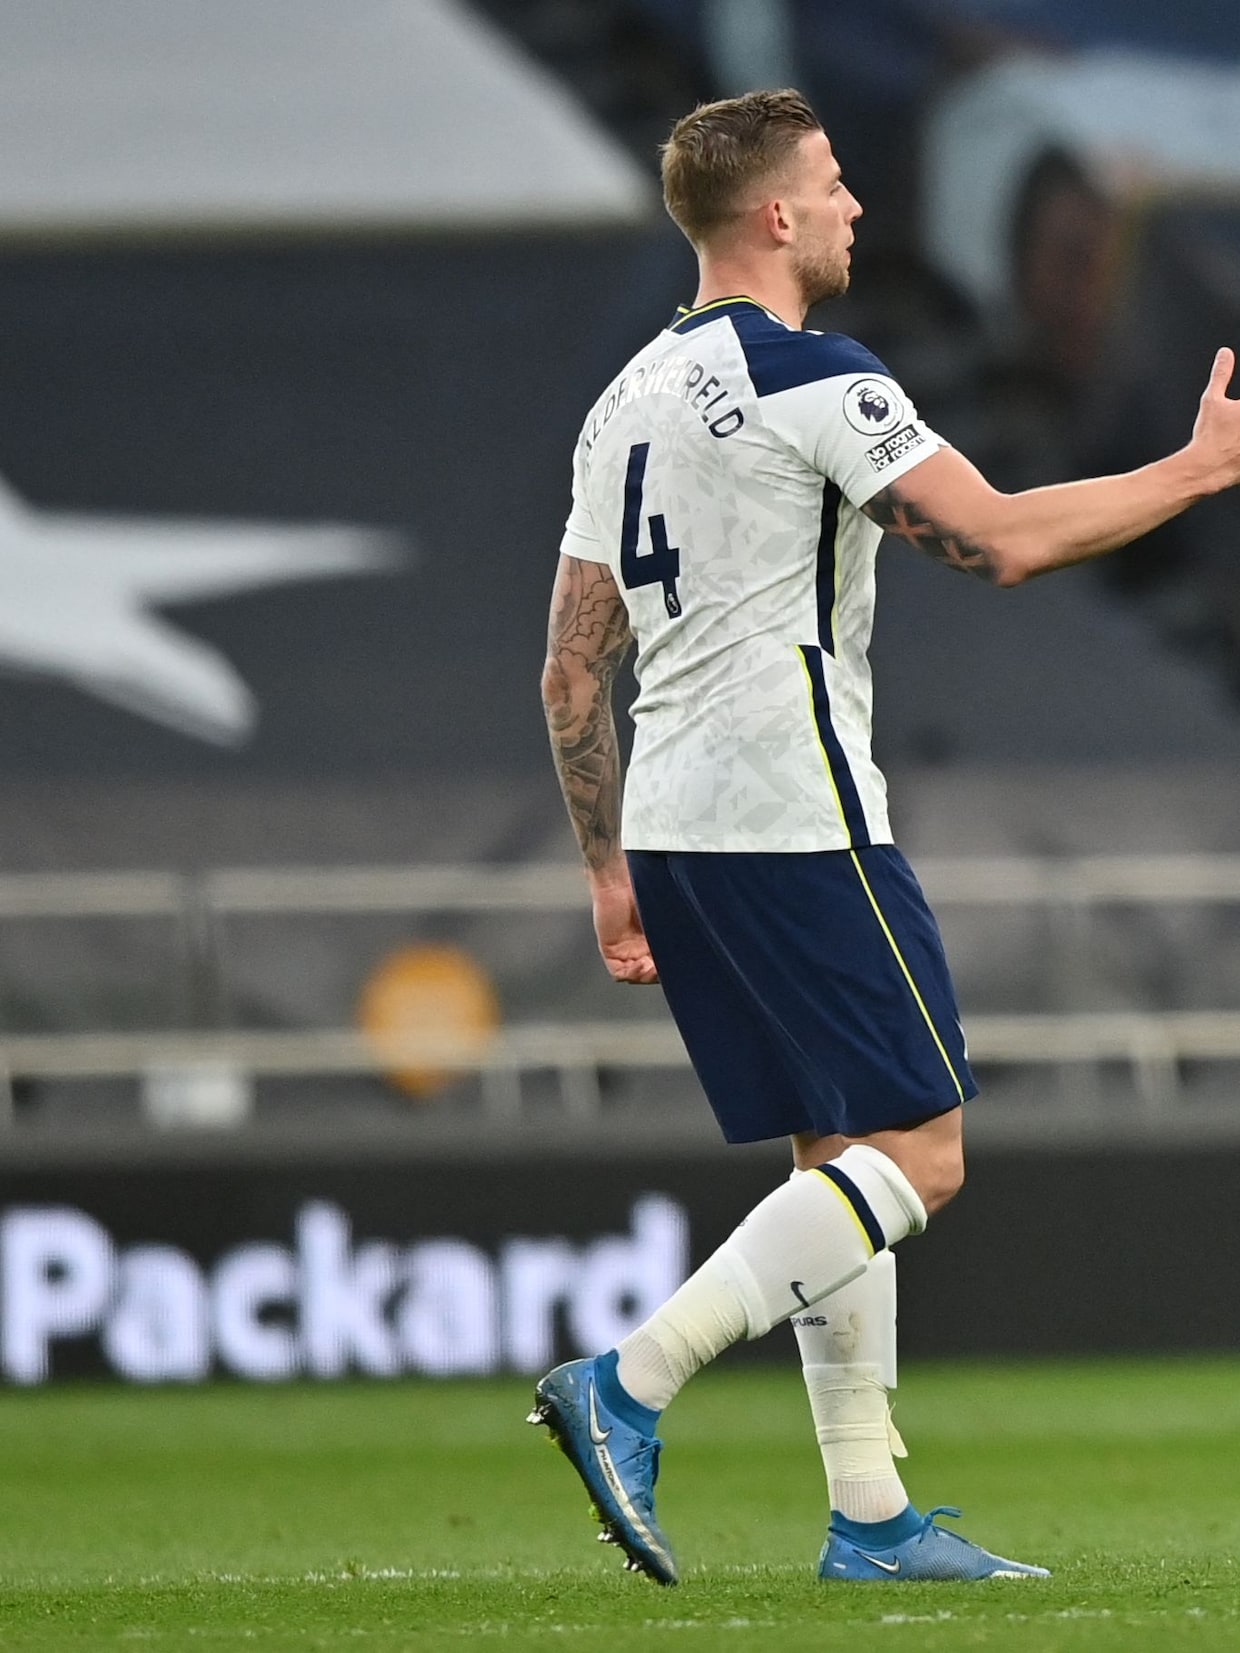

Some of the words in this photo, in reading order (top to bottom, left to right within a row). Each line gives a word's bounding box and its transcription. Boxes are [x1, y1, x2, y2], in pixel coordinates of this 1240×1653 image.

[620, 442, 680, 619] 4
[866, 447, 886, 462] No
[885, 429, 915, 451] room
[1, 1192, 688, 1383] Packard
